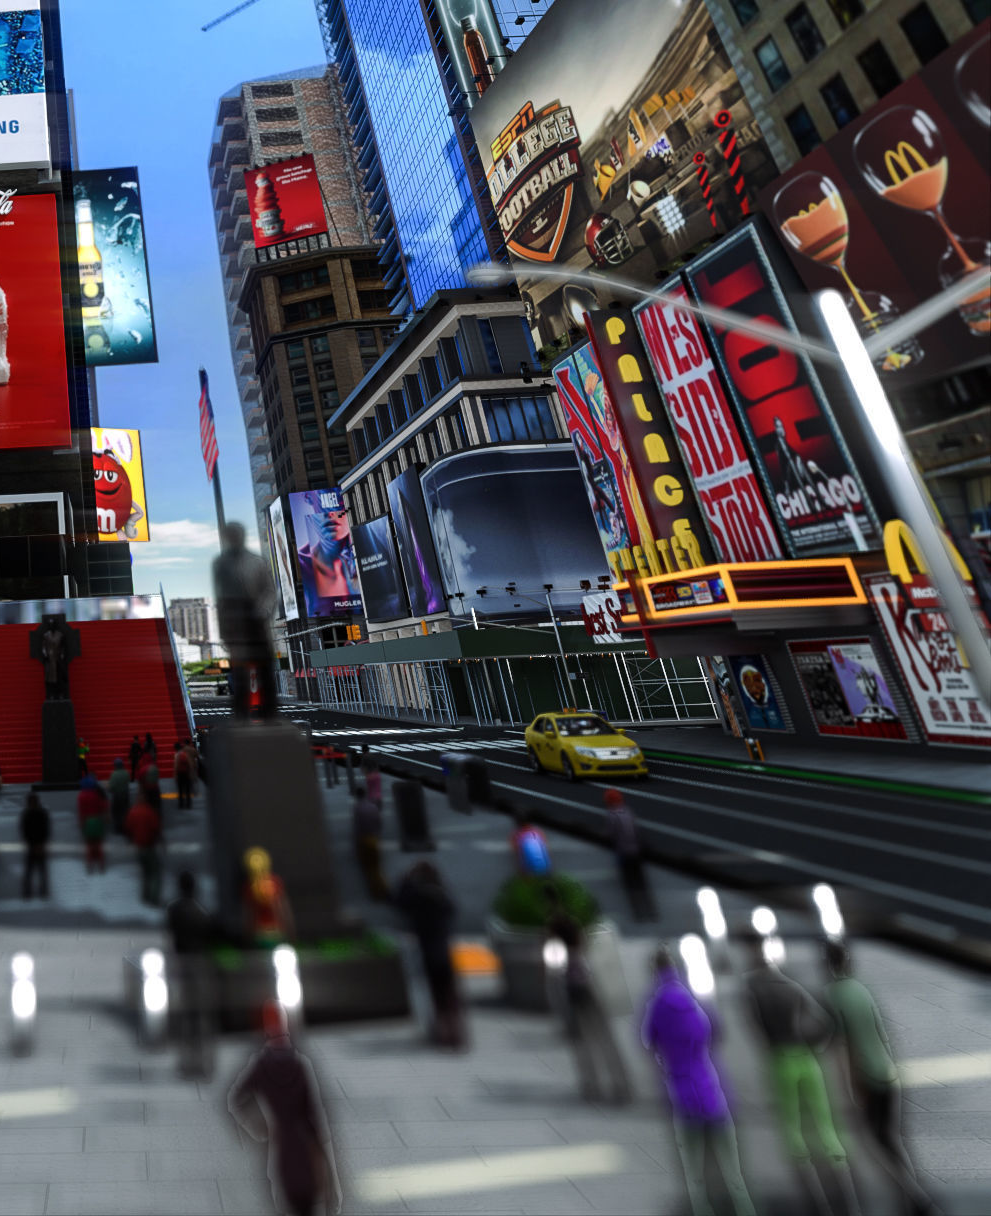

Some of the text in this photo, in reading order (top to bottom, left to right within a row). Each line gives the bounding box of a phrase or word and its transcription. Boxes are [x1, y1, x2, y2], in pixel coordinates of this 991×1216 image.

[487, 106, 577, 205] OLLEGE
[491, 101, 535, 161] ESPN
[499, 152, 578, 231] OOTBALL
[605, 316, 692, 547] PALACE
[320, 492, 340, 509] ANGEL
[608, 533, 706, 583] THEATER
[334, 599, 362, 608] MUGLER
